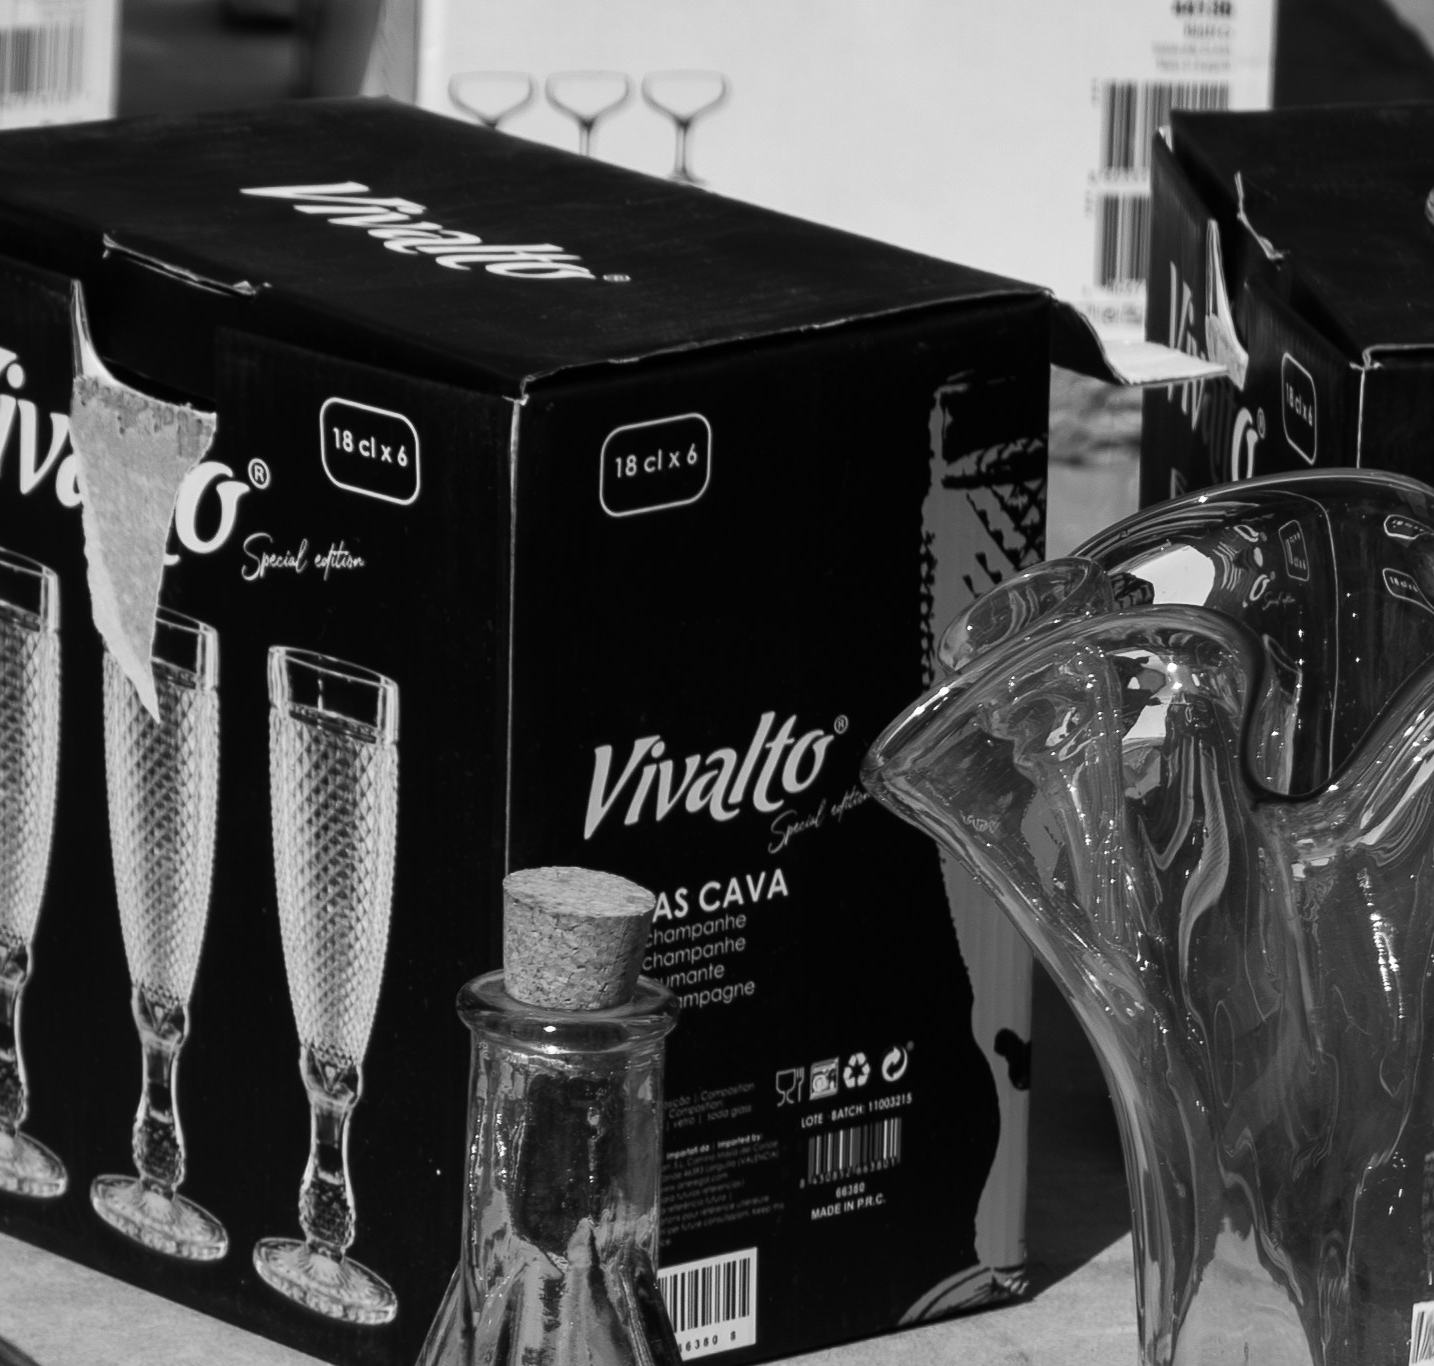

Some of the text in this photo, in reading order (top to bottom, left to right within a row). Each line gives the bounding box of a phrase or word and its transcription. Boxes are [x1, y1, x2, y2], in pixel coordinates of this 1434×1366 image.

[239, 180, 598, 281] Vivalto
[332, 427, 409, 467] 18 cl x 6
[616, 442, 697, 478] 18 cl x 6
[241, 532, 366, 581] Special edition
[584, 711, 834, 840] Vivalto
[768, 809, 826, 854] Special
[698, 868, 789, 912] CAVA
[644, 913, 747, 948] champanhe
[642, 936, 746, 971] champanhe
[653, 962, 725, 988] umante
[678, 980, 756, 1009] mpagne
[801, 1113, 824, 1129] LOTE
[811, 1202, 841, 1220] MADE
[843, 1200, 855, 1213] IN
